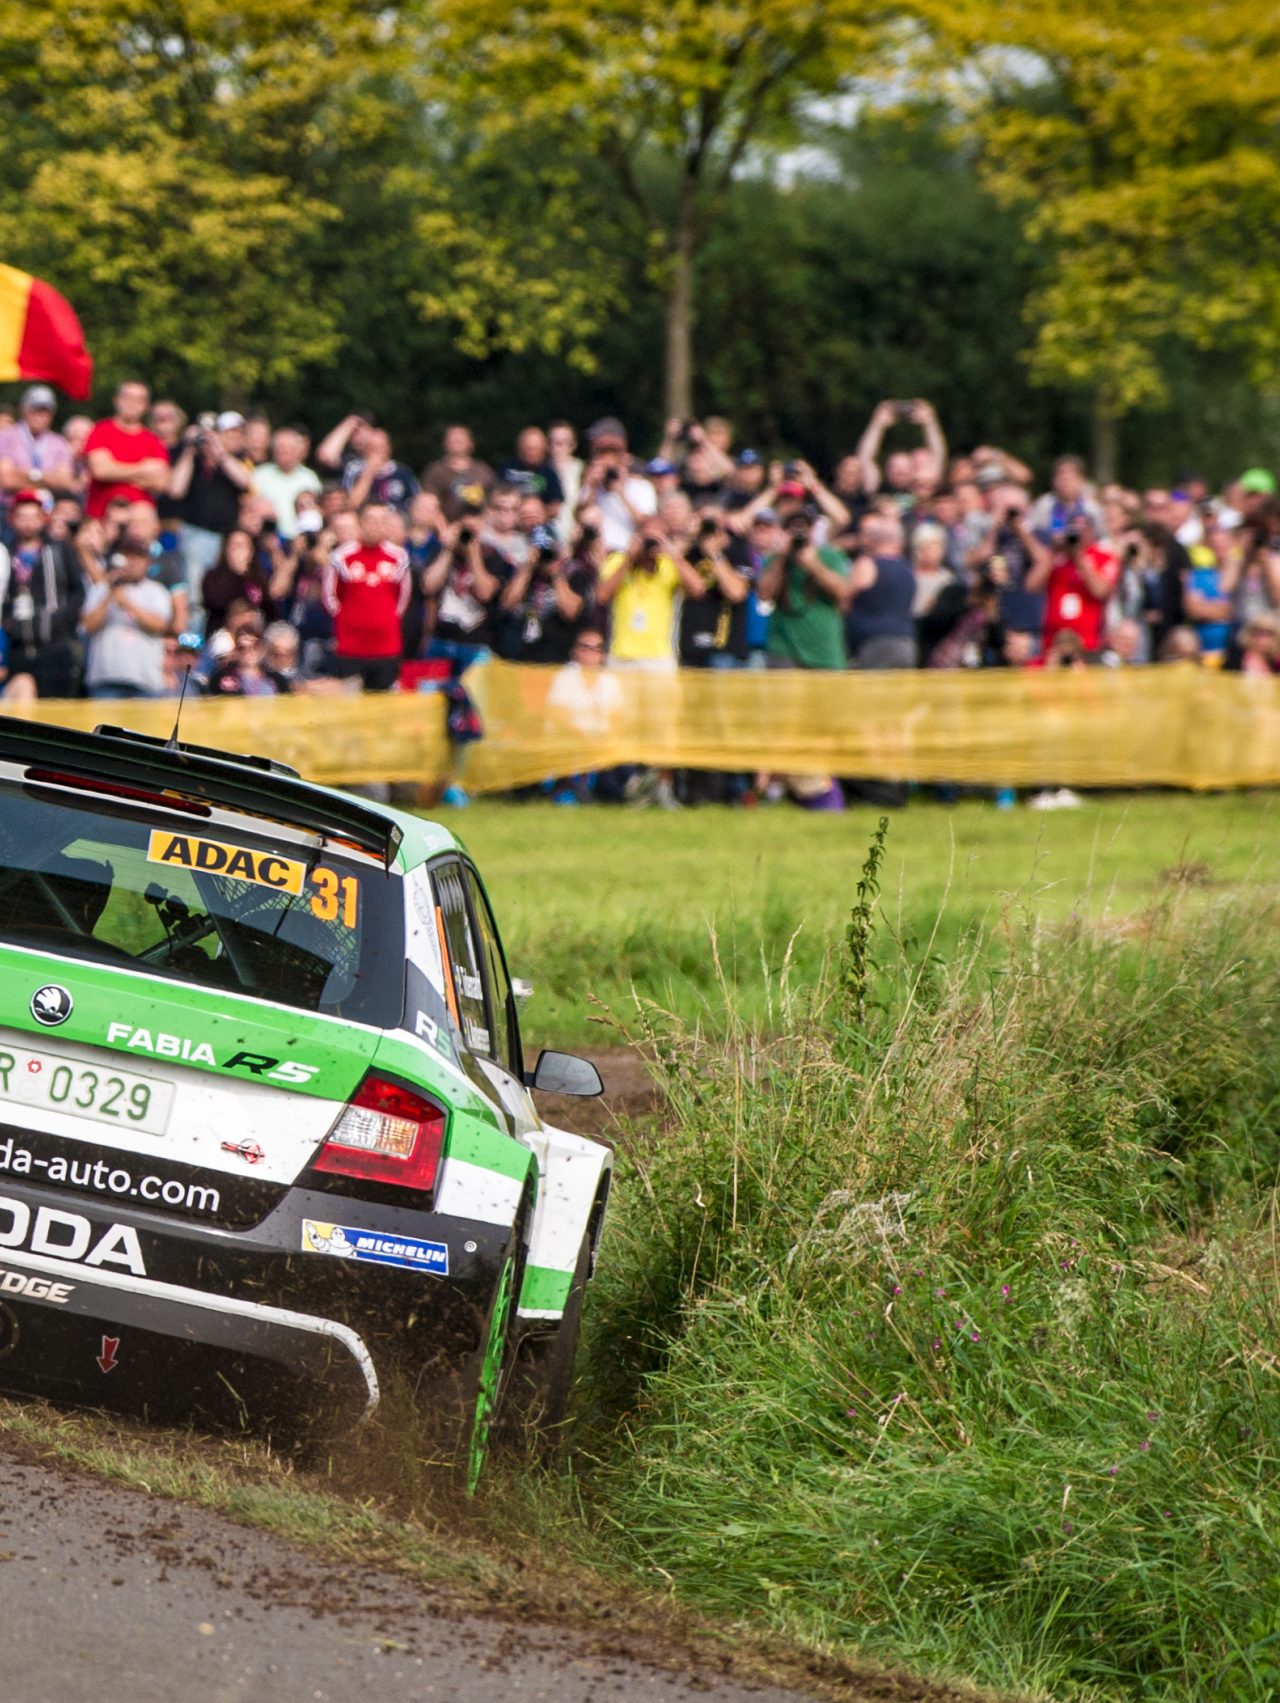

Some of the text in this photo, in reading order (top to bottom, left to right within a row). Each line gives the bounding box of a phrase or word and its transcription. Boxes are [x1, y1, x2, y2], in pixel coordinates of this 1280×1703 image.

[161, 836, 290, 887] ADAC
[310, 867, 358, 929] 31
[106, 1021, 320, 1084] FABIA R5
[415, 1009, 452, 1059] R5
[49, 1065, 152, 1121] 0329
[356, 1237, 446, 1263] MICHELIN
